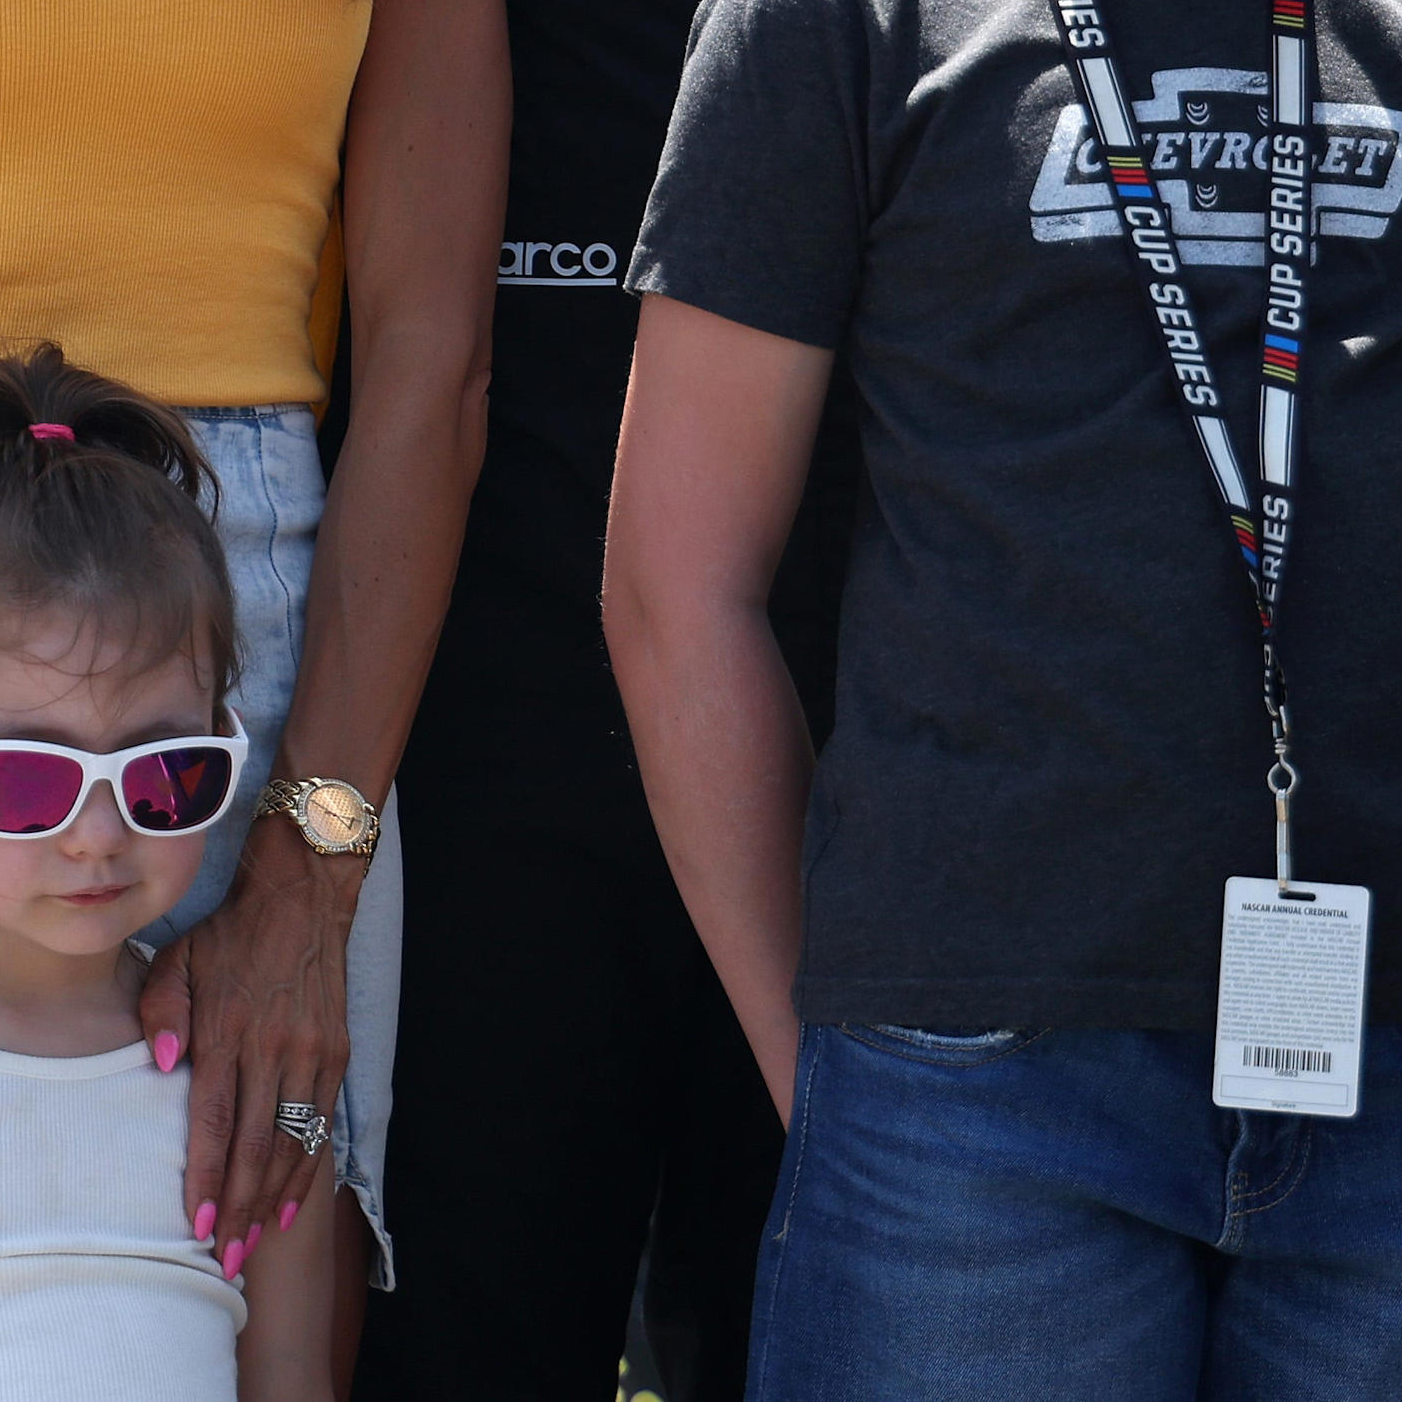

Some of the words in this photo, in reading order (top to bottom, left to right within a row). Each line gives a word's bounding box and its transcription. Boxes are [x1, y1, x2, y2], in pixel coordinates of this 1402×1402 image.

[1075, 130, 1388, 177] CEVRET
[1270, 134, 1304, 256] SERIES
[498, 241, 617, 277] arco
[1124, 205, 1177, 275] CUP
[1267, 263, 1302, 331] CUP
[1149, 282, 1218, 407] SERIES
[1304, 907, 1349, 919] CREDENTIAL
